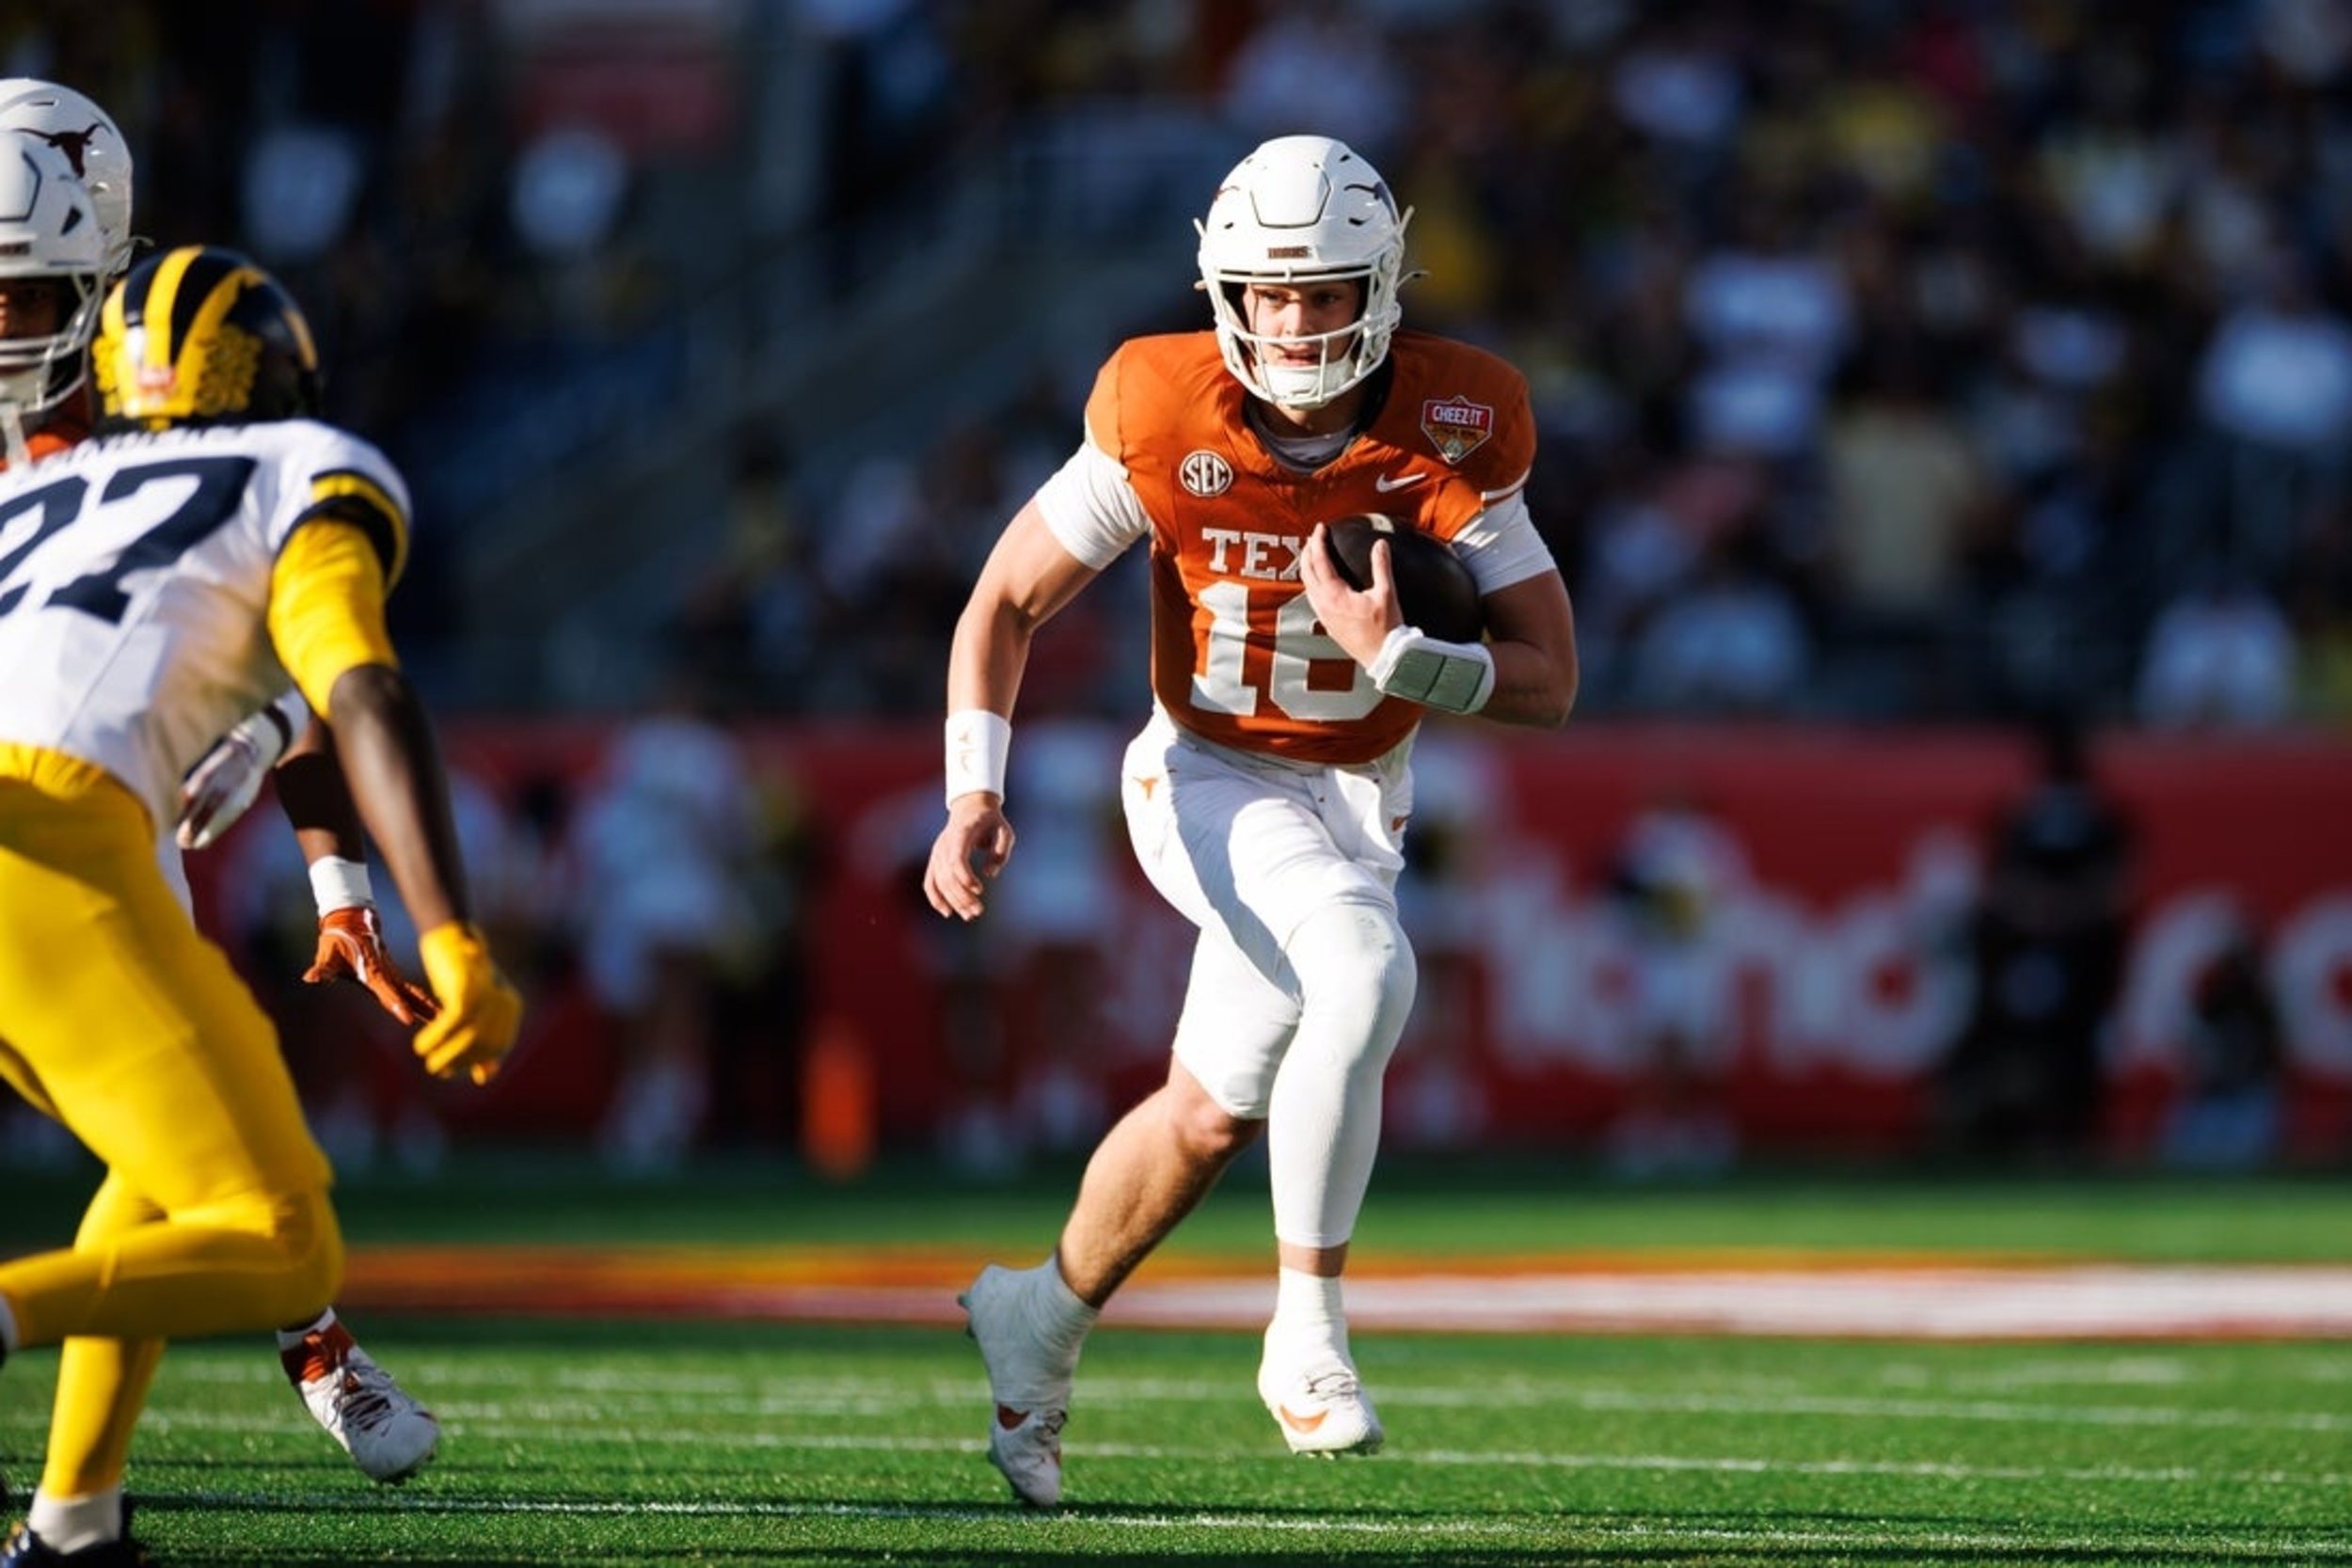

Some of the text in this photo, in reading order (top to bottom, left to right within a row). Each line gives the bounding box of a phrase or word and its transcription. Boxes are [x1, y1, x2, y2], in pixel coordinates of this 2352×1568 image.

[1184, 454, 1227, 493] SEC
[1201, 528, 1304, 581] TEX
[1189, 579, 1387, 722] 16
